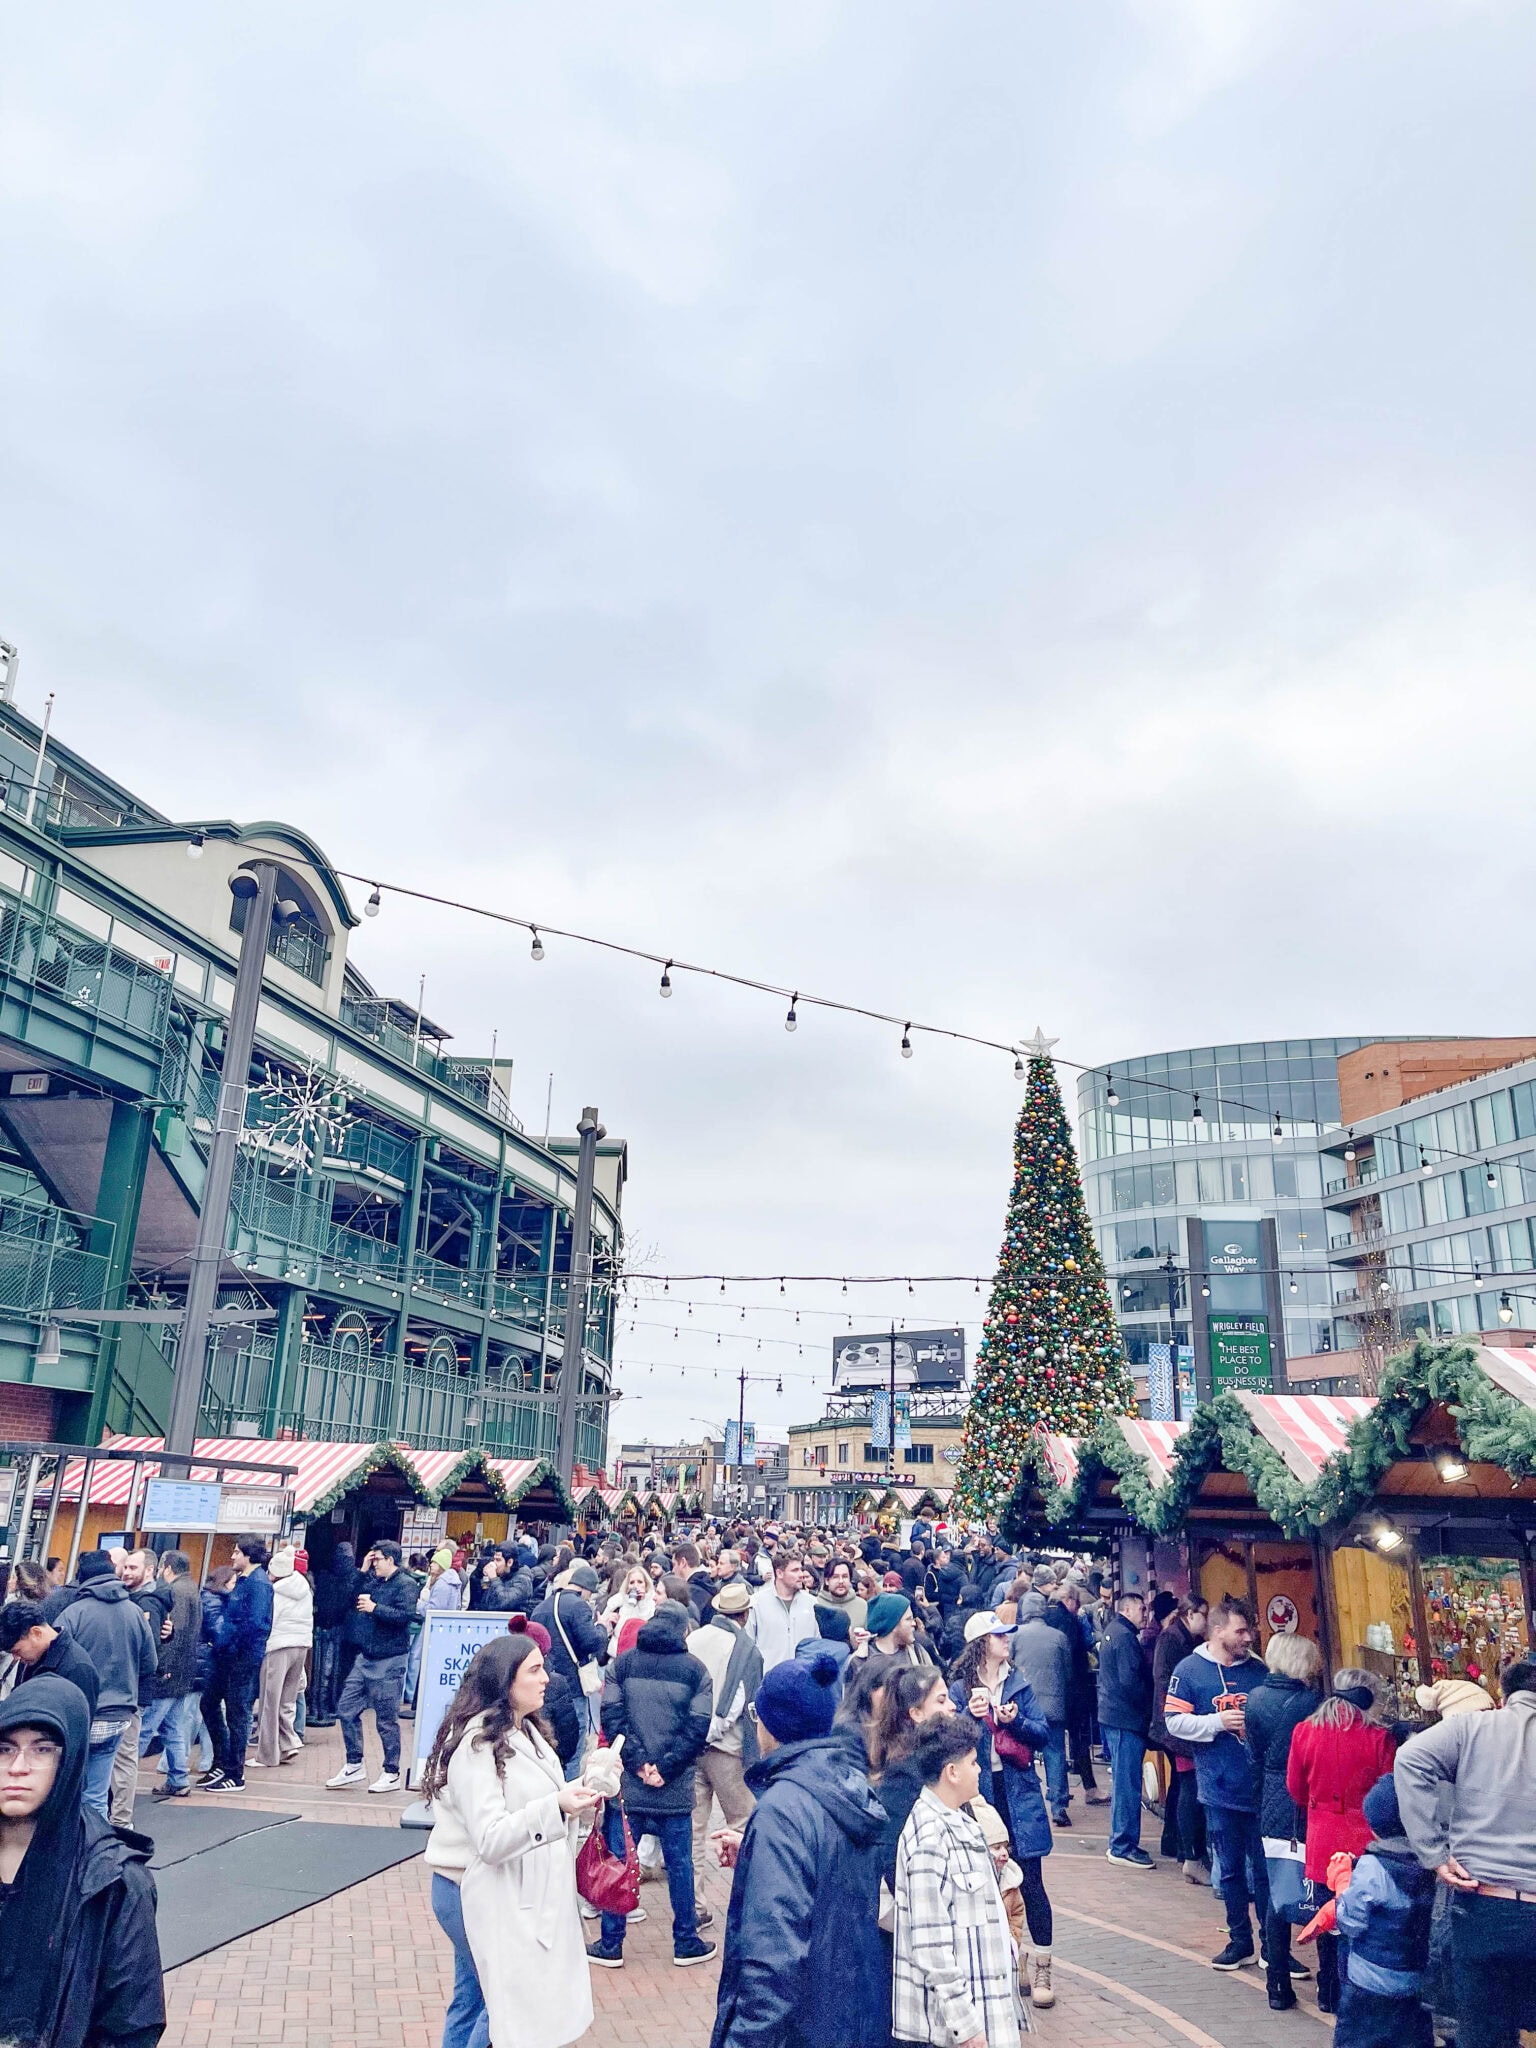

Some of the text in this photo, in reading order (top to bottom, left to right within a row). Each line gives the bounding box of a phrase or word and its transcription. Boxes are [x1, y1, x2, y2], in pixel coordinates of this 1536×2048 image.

[28, 1078, 43, 1089] EXIT
[1210, 1256, 1258, 1266] Gallagher
[1212, 1322, 1265, 1333] WRIGLEY FIELD
[1220, 1356, 1262, 1364] PLACE TO
[1234, 1366, 1249, 1374] DO
[1153, 1355, 1168, 1413] Winterland
[1217, 1377, 1268, 1385] BUSINESS IN
[226, 1501, 276, 1517] BUD LIGHT
